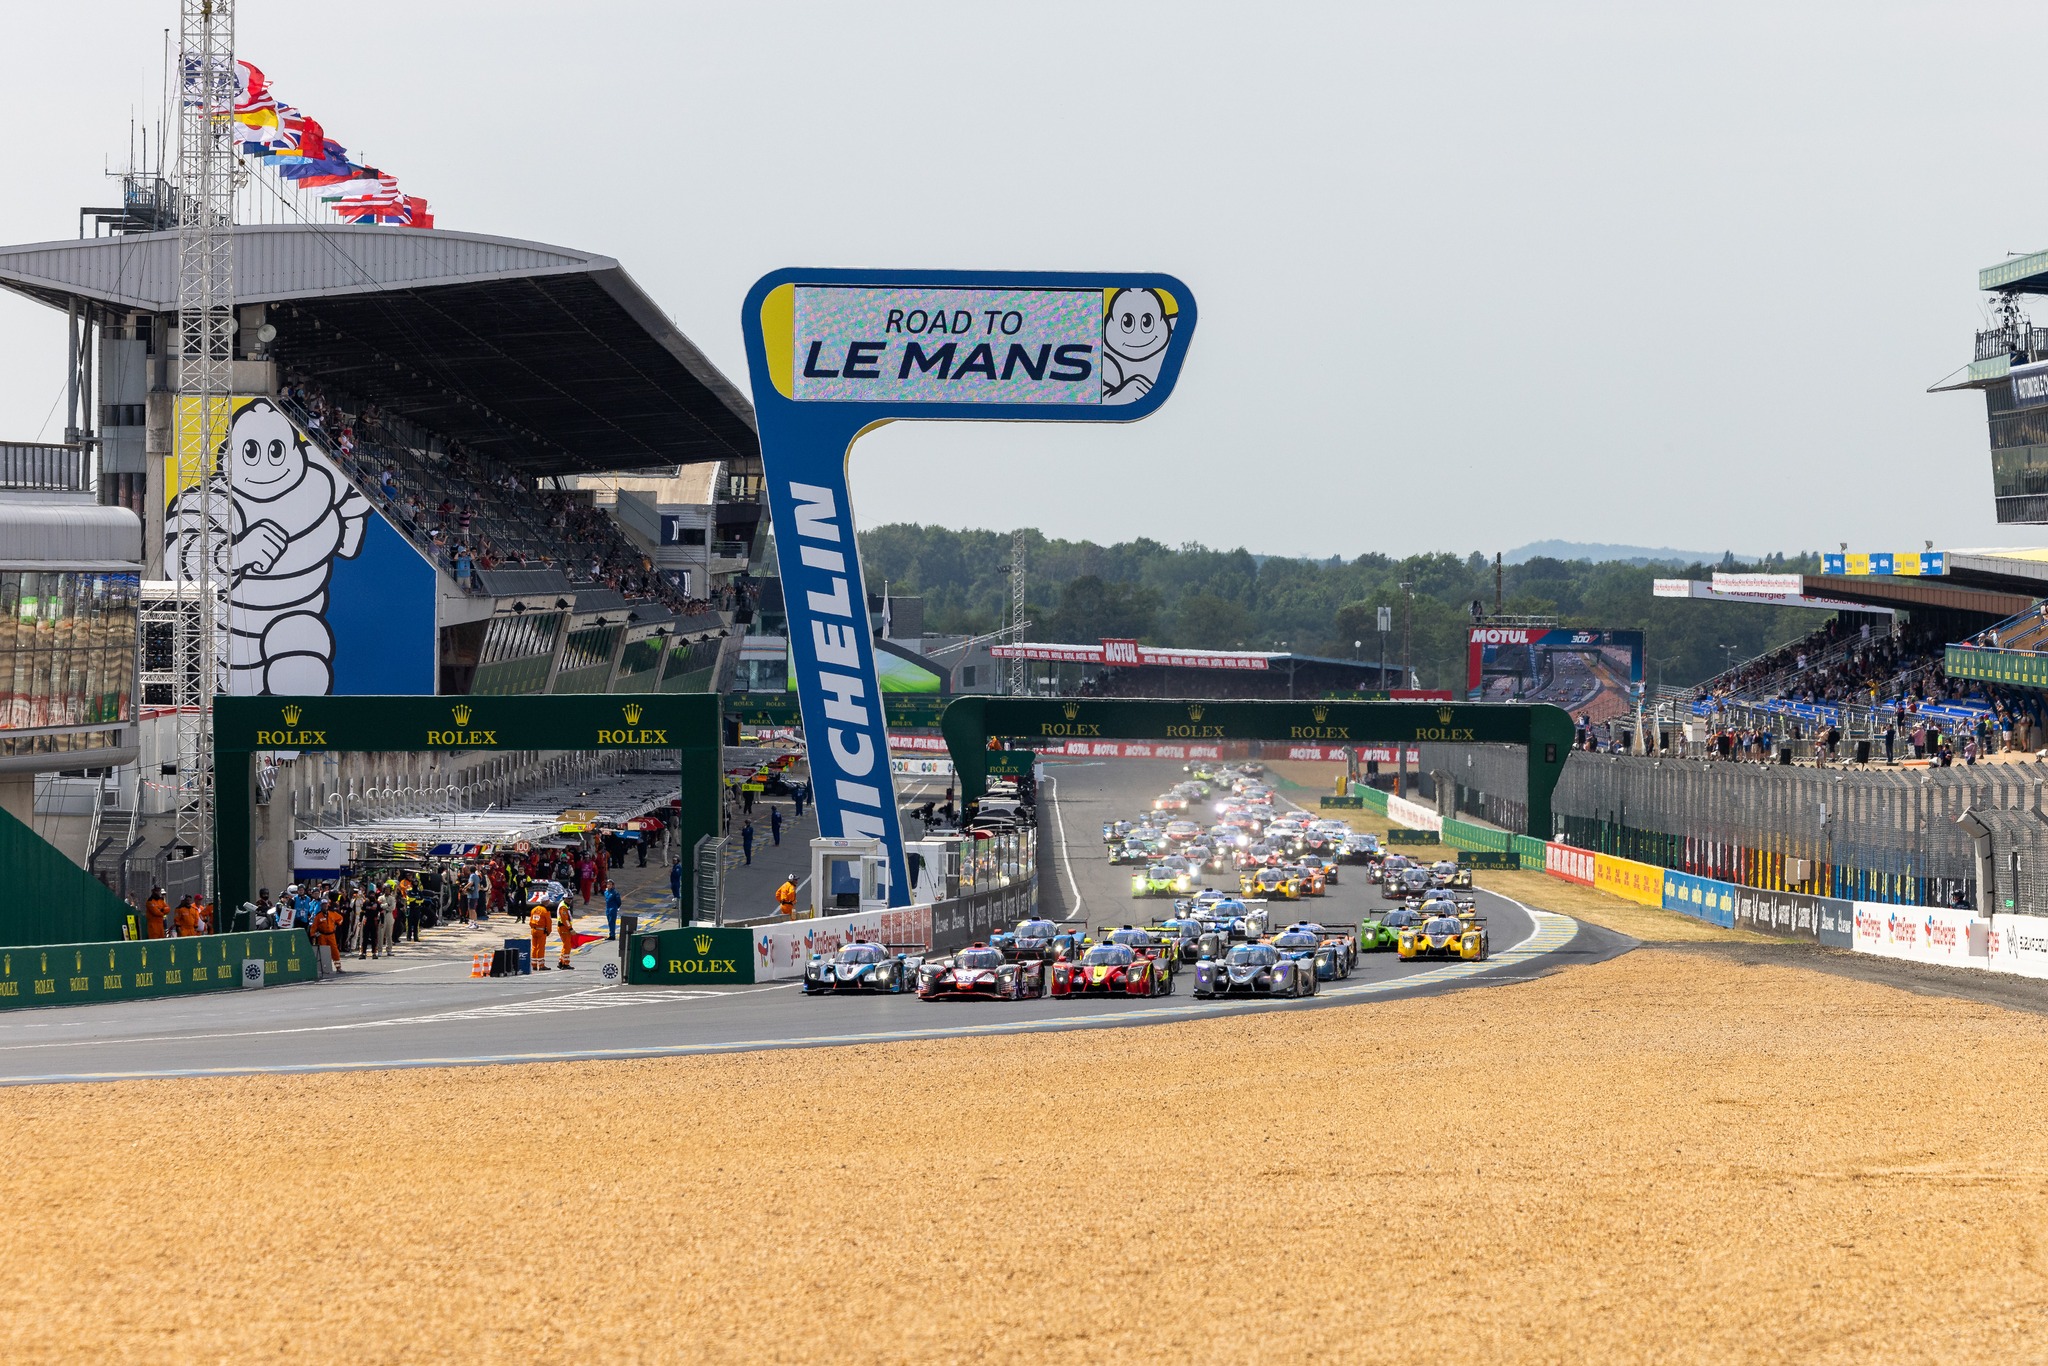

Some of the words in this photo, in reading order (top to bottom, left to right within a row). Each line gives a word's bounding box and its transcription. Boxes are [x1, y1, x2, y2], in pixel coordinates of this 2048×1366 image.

[885, 309, 972, 334] ROAD
[984, 310, 1023, 335] TO
[803, 341, 886, 379] LE
[898, 342, 1093, 381] MANS
[1470, 629, 1529, 643] MOTUL
[1105, 642, 1138, 663] MOTUL
[1041, 723, 1101, 736] ROLEX
[1166, 725, 1225, 738] ROLEX
[1290, 726, 1350, 739] ROLEX
[1415, 728, 1474, 741] ROLEX
[256, 730, 328, 745] ROLEX
[427, 730, 498, 745] ROLEX
[597, 729, 669, 745] ROLEX
[1067, 743, 1089, 755] MOTUL
[1093, 744, 1119, 756] MOTUL
[1125, 745, 1151, 757] MOTUL
[1156, 746, 1185, 759] MOTUL
[1189, 746, 1218, 759] MOTUL
[1289, 747, 1321, 760] MOTUL
[578, 812, 586, 821] 14
[449, 843, 465, 855] 24
[516, 842, 529, 851] 100
[669, 959, 737, 974] ROLEX
[34, 979, 55, 994] ROLEX
[70, 977, 89, 992] ROLEX
[104, 974, 122, 990] ROLEX
[136, 972, 154, 987] ROLEX
